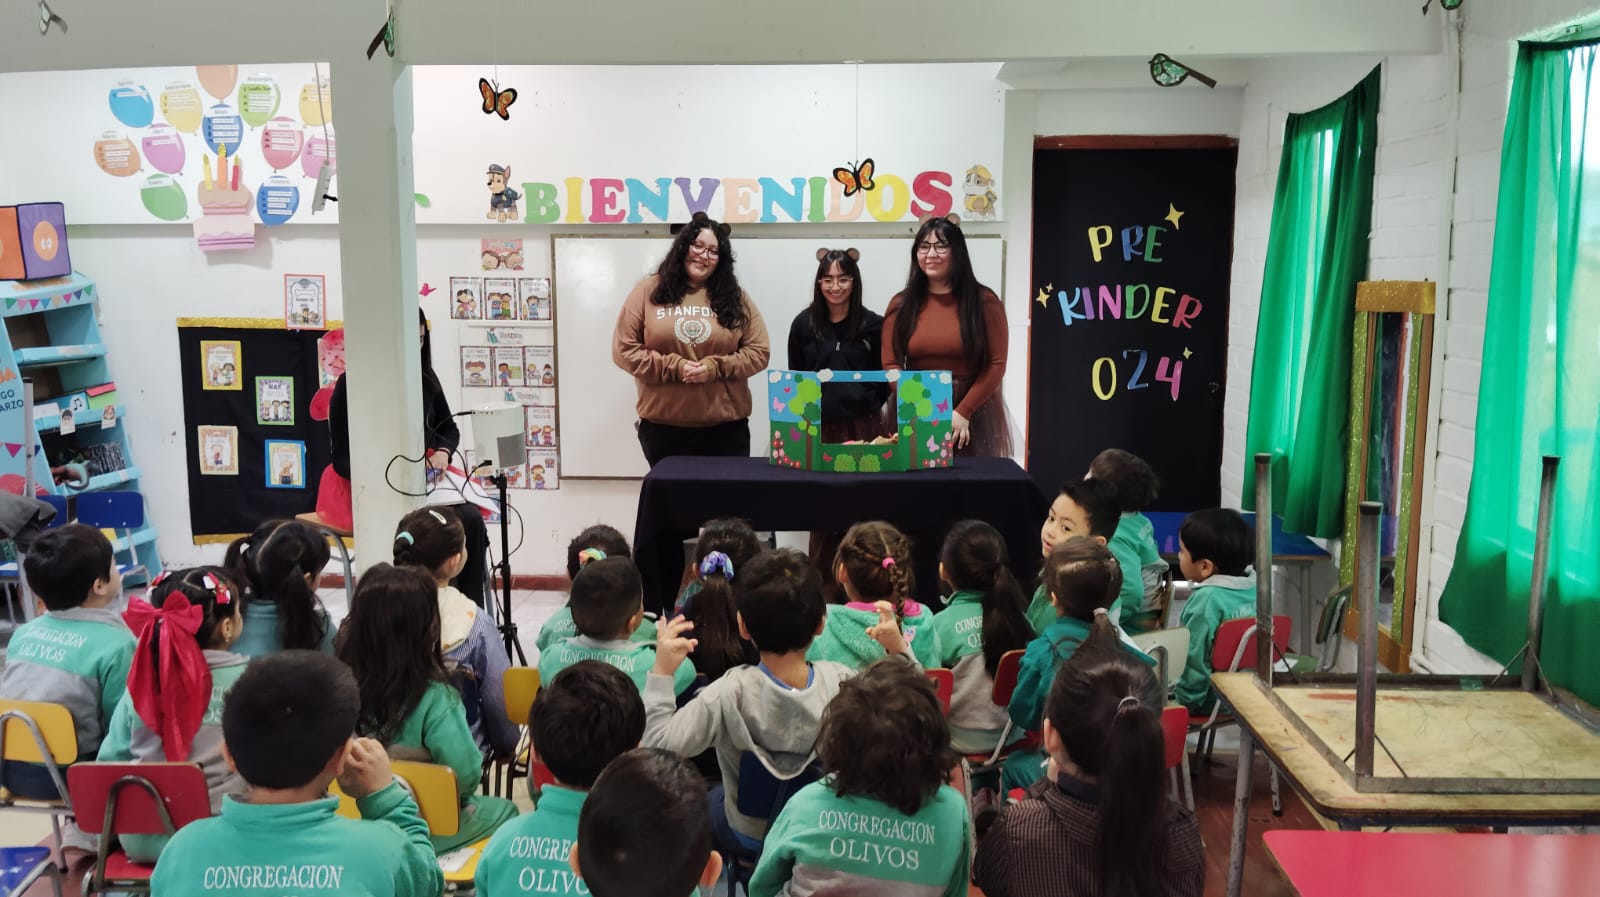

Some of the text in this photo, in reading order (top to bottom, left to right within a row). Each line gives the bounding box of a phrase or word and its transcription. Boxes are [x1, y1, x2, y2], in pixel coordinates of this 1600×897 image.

[522, 170, 954, 225] BIENVENIDOS
[1088, 224, 1168, 263] PRE
[1058, 283, 1203, 329] KINDER
[1091, 349, 1184, 402] 024
[18, 641, 66, 662] OLIVOS
[819, 809, 936, 845] CONGREGACION
[830, 837, 920, 870] OLIVOS
[203, 864, 344, 889] CONGREGACION
